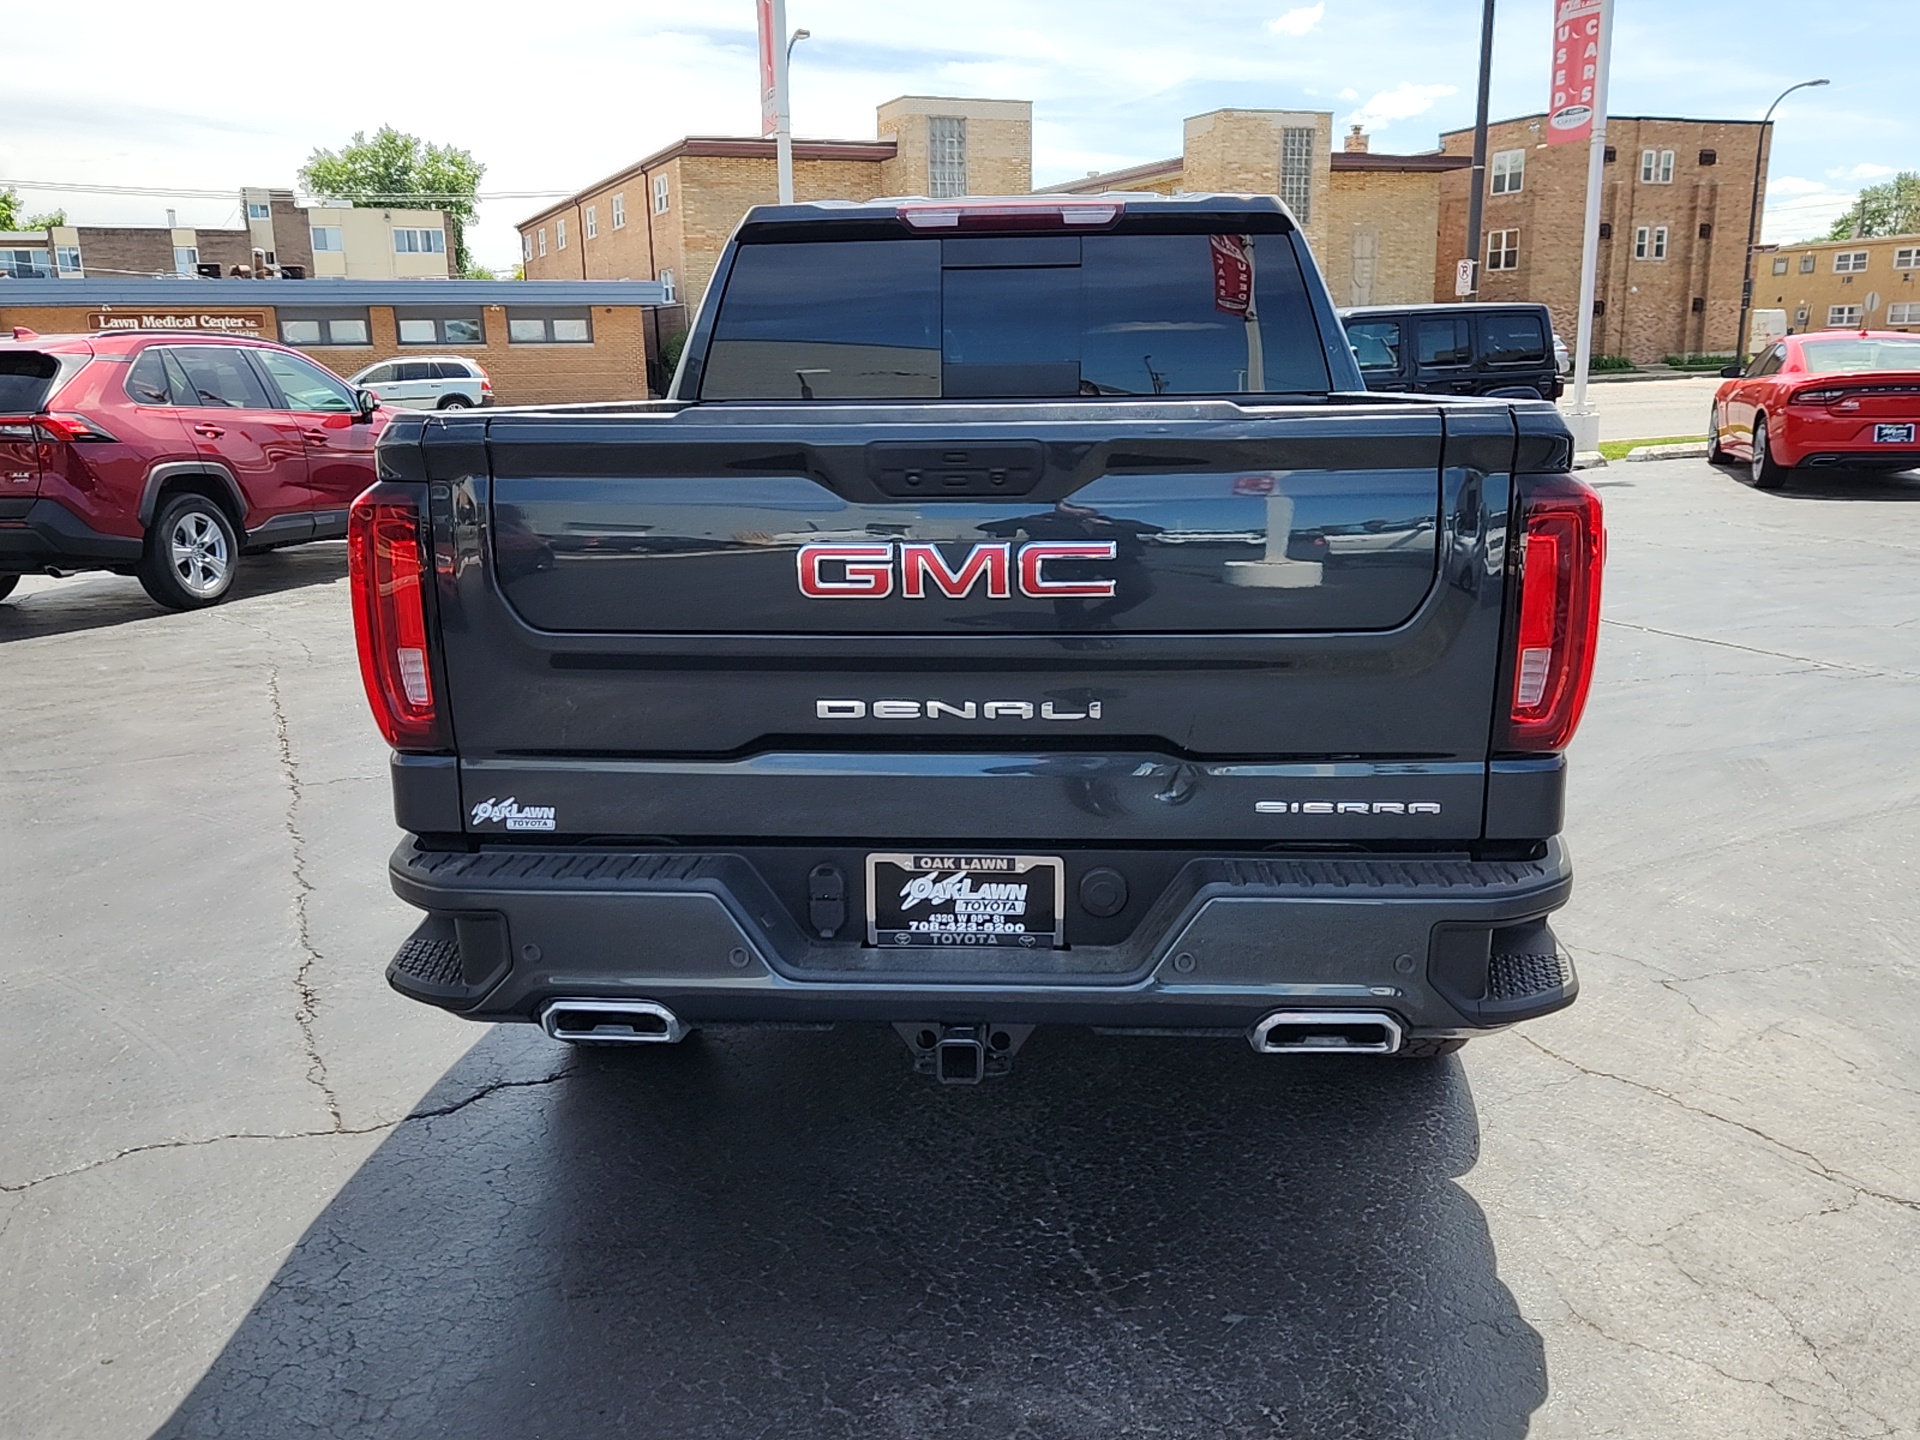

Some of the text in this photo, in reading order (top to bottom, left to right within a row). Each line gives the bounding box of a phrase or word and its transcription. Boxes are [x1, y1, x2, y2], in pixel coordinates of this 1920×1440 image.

[1554, 25, 1569, 107] USED
[1581, 19, 1597, 102] CARS
[98, 315, 139, 330] Lawn
[142, 314, 197, 328] Medical
[200, 315, 245, 331] Center
[796, 540, 1117, 599] GMC
[816, 699, 1101, 719] DENALI
[1254, 801, 1441, 814] SIERRA
[920, 857, 1008, 870] OAK LAWN
[963, 901, 1016, 912] TOYOTA
[928, 913, 954, 922] 4320
[957, 914, 968, 923] W
[993, 914, 1005, 923] St
[930, 933, 998, 945] TOYOTA
